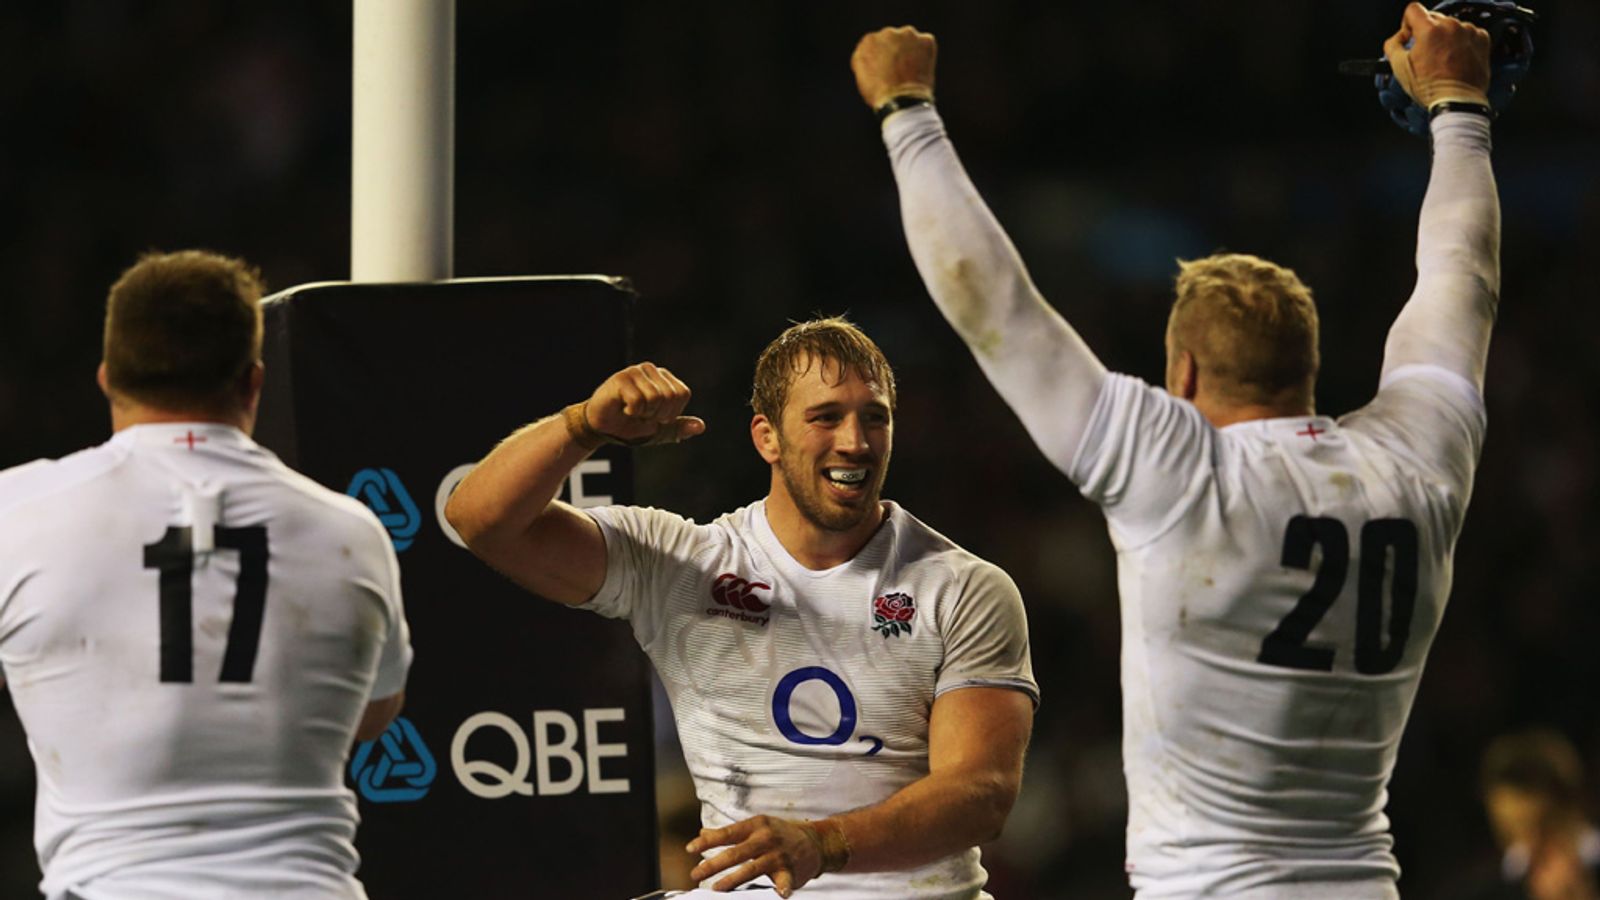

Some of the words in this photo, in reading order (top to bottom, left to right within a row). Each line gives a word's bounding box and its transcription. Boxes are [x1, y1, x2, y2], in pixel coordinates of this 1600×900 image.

[143, 525, 270, 684] 17
[706, 608, 770, 627] canterbury
[1256, 515, 1420, 676] 20
[450, 707, 631, 799] QBE
